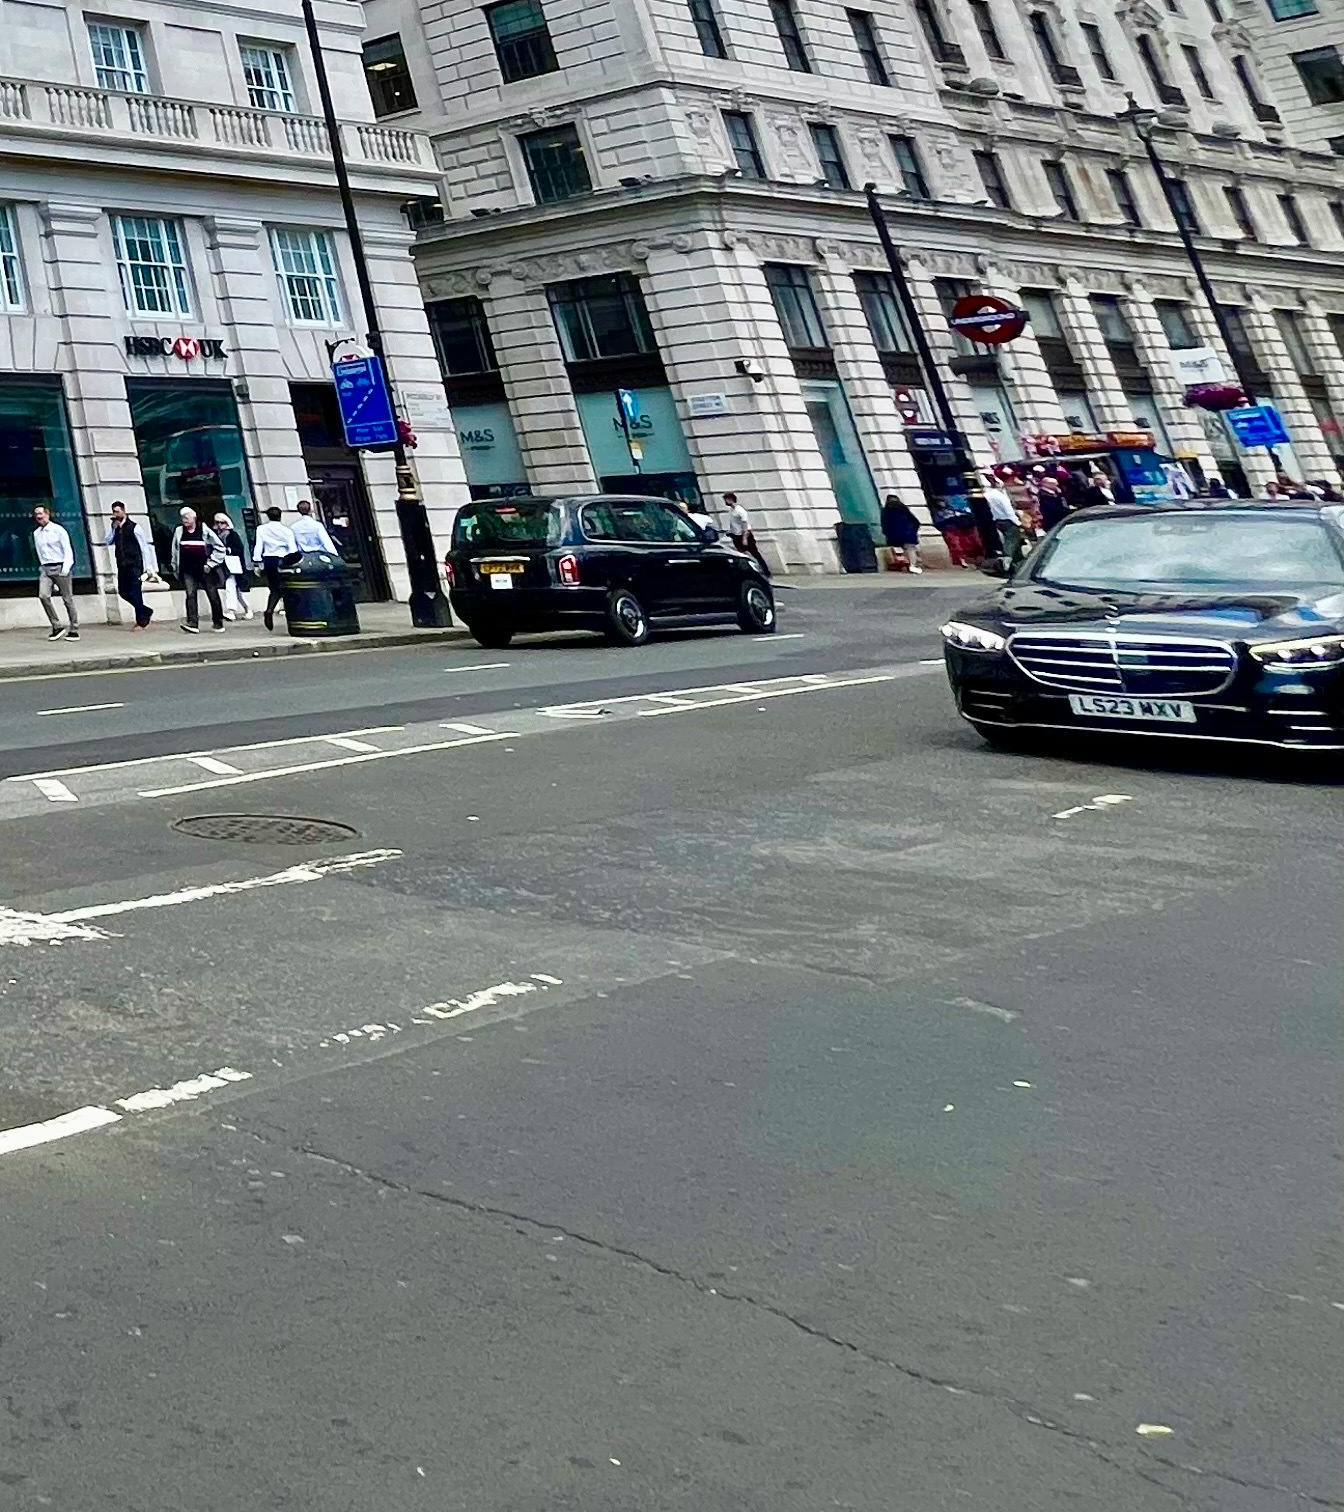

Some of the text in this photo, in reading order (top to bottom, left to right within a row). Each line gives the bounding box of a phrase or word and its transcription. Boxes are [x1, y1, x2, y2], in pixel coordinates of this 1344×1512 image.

[124, 336, 228, 359] HSBC UK
[459, 428, 495, 444] M&S
[1078, 696, 1135, 715] LS23
